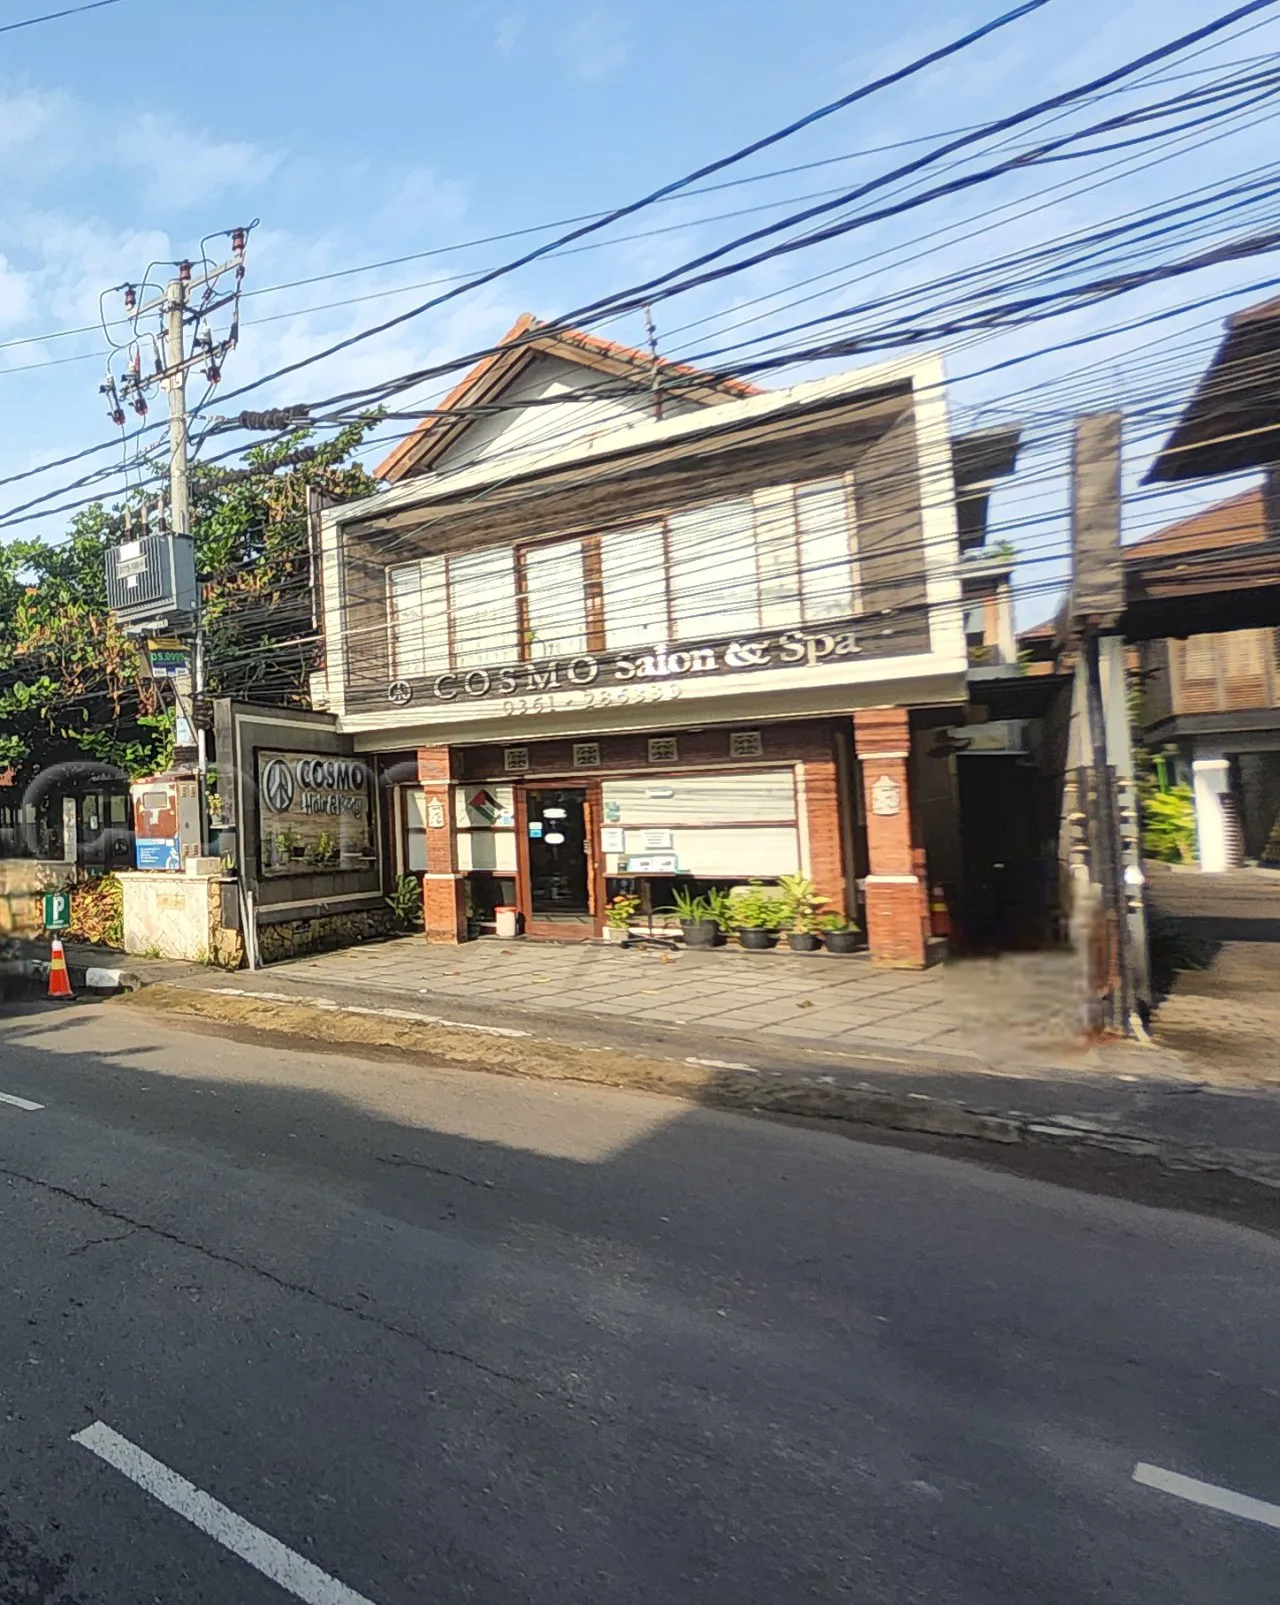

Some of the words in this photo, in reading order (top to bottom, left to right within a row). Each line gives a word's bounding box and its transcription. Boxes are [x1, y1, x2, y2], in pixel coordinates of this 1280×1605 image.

[433, 656, 600, 700] COSMO
[724, 640, 771, 668] &
[779, 631, 863, 668] Spa
[297, 760, 364, 791] COSMO
[52, 896, 65, 921] P
